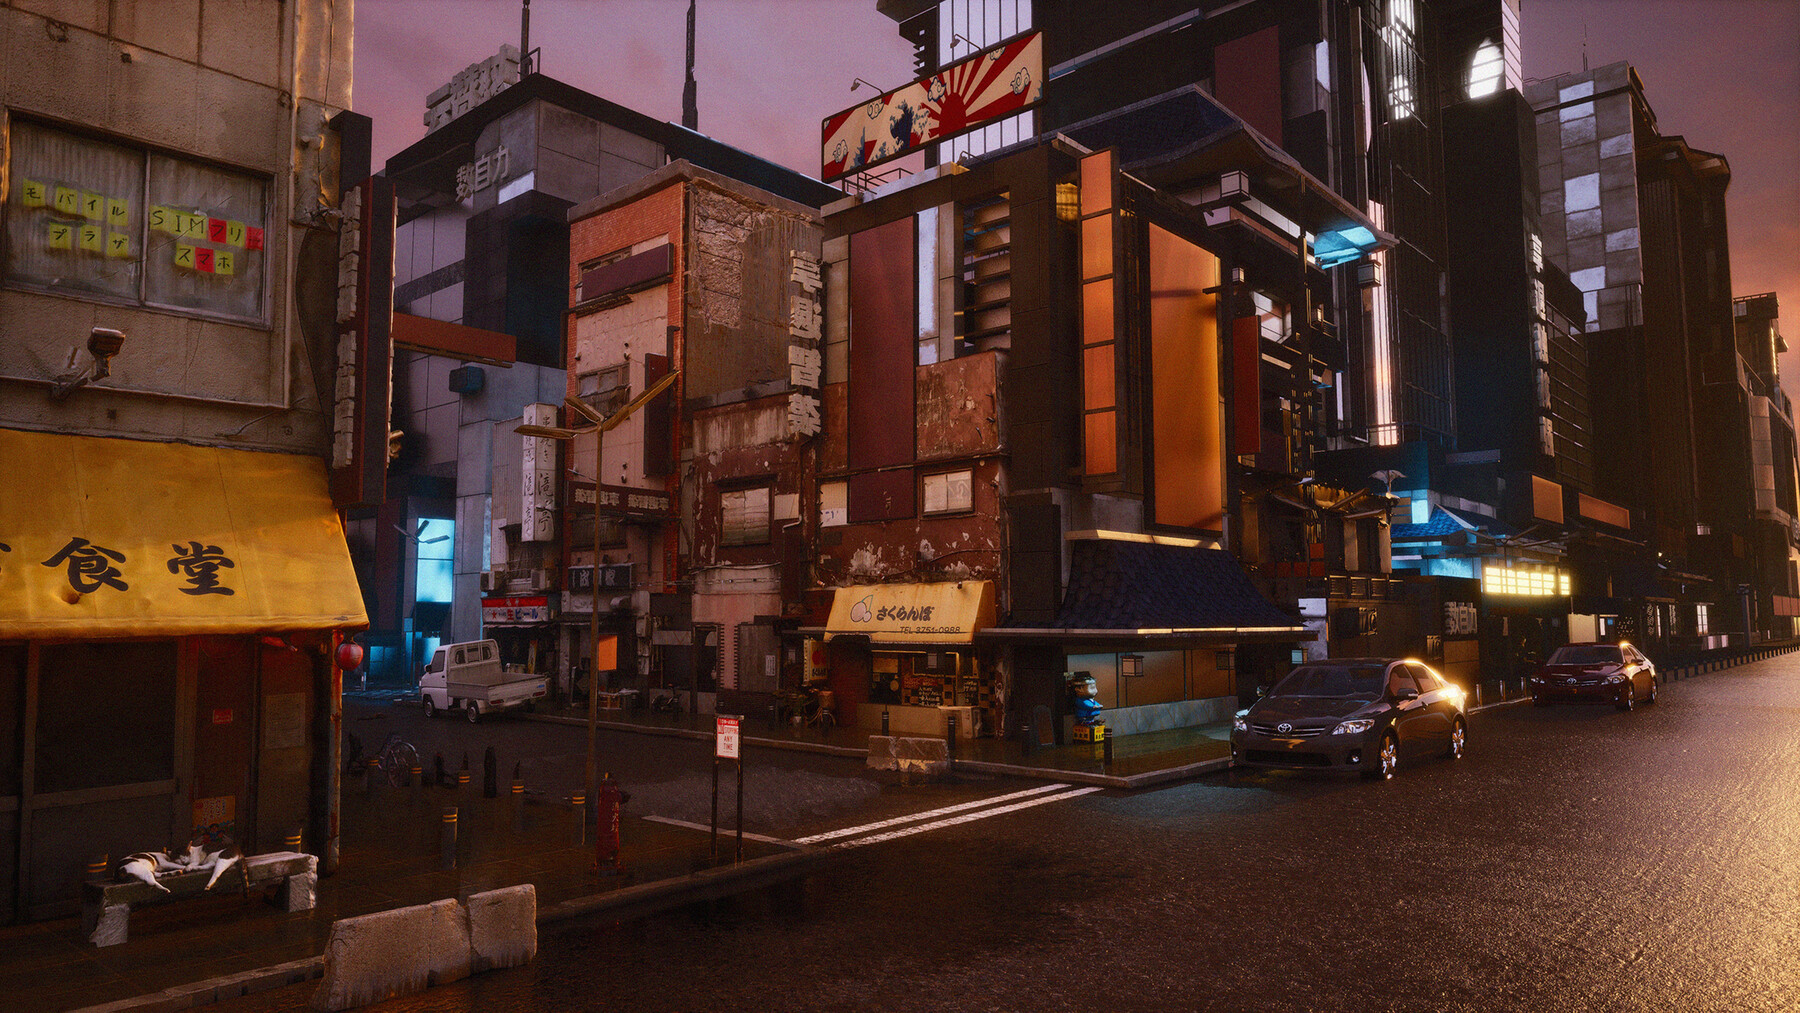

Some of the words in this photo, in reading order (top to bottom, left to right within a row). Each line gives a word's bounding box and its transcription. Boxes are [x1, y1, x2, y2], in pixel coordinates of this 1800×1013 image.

[25, 187, 126, 217] モバイル
[53, 228, 128, 249] プラザ
[178, 247, 231, 269] スマホ
[0, 536, 236, 596] 食堂
[876, 605, 936, 622] さくらんぼ
[899, 626, 913, 634] TEL
